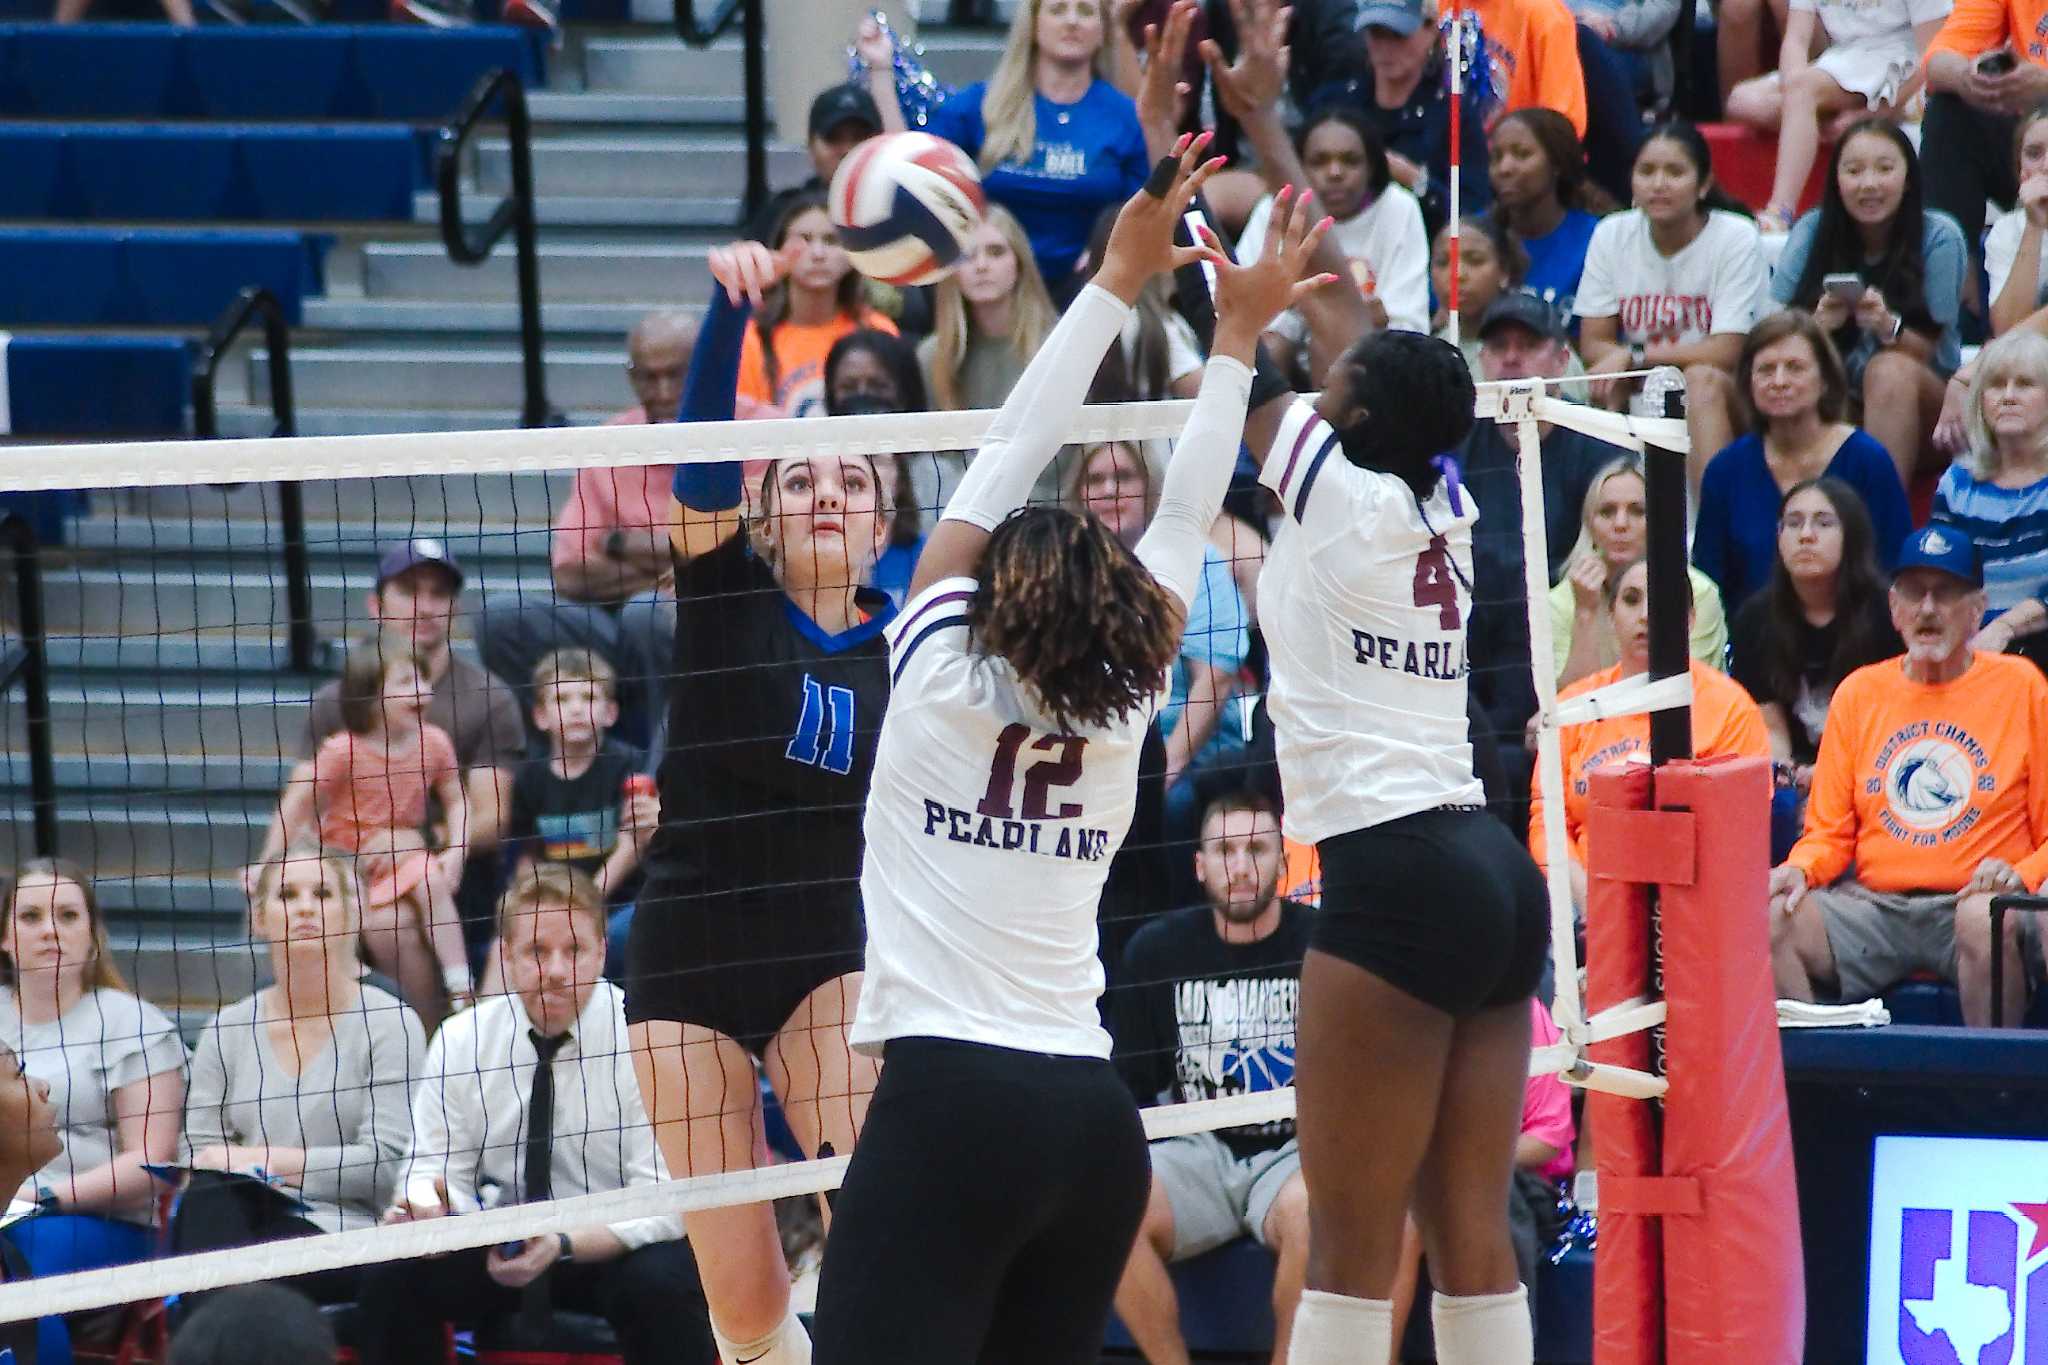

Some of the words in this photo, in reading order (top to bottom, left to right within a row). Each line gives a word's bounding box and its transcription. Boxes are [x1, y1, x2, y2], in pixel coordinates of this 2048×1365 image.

[1413, 533, 1461, 630] 4
[785, 672, 855, 776] 11
[1875, 720, 1930, 771] DISTRICT
[1934, 721, 1988, 768] CHAMPS
[976, 721, 1090, 820] 12
[1866, 777, 1882, 795] 20
[1977, 775, 1995, 792] 22
[1878, 808, 1909, 842] FIGHT
[1911, 833, 1938, 846] FOR
[1942, 806, 1981, 843] MOORE
